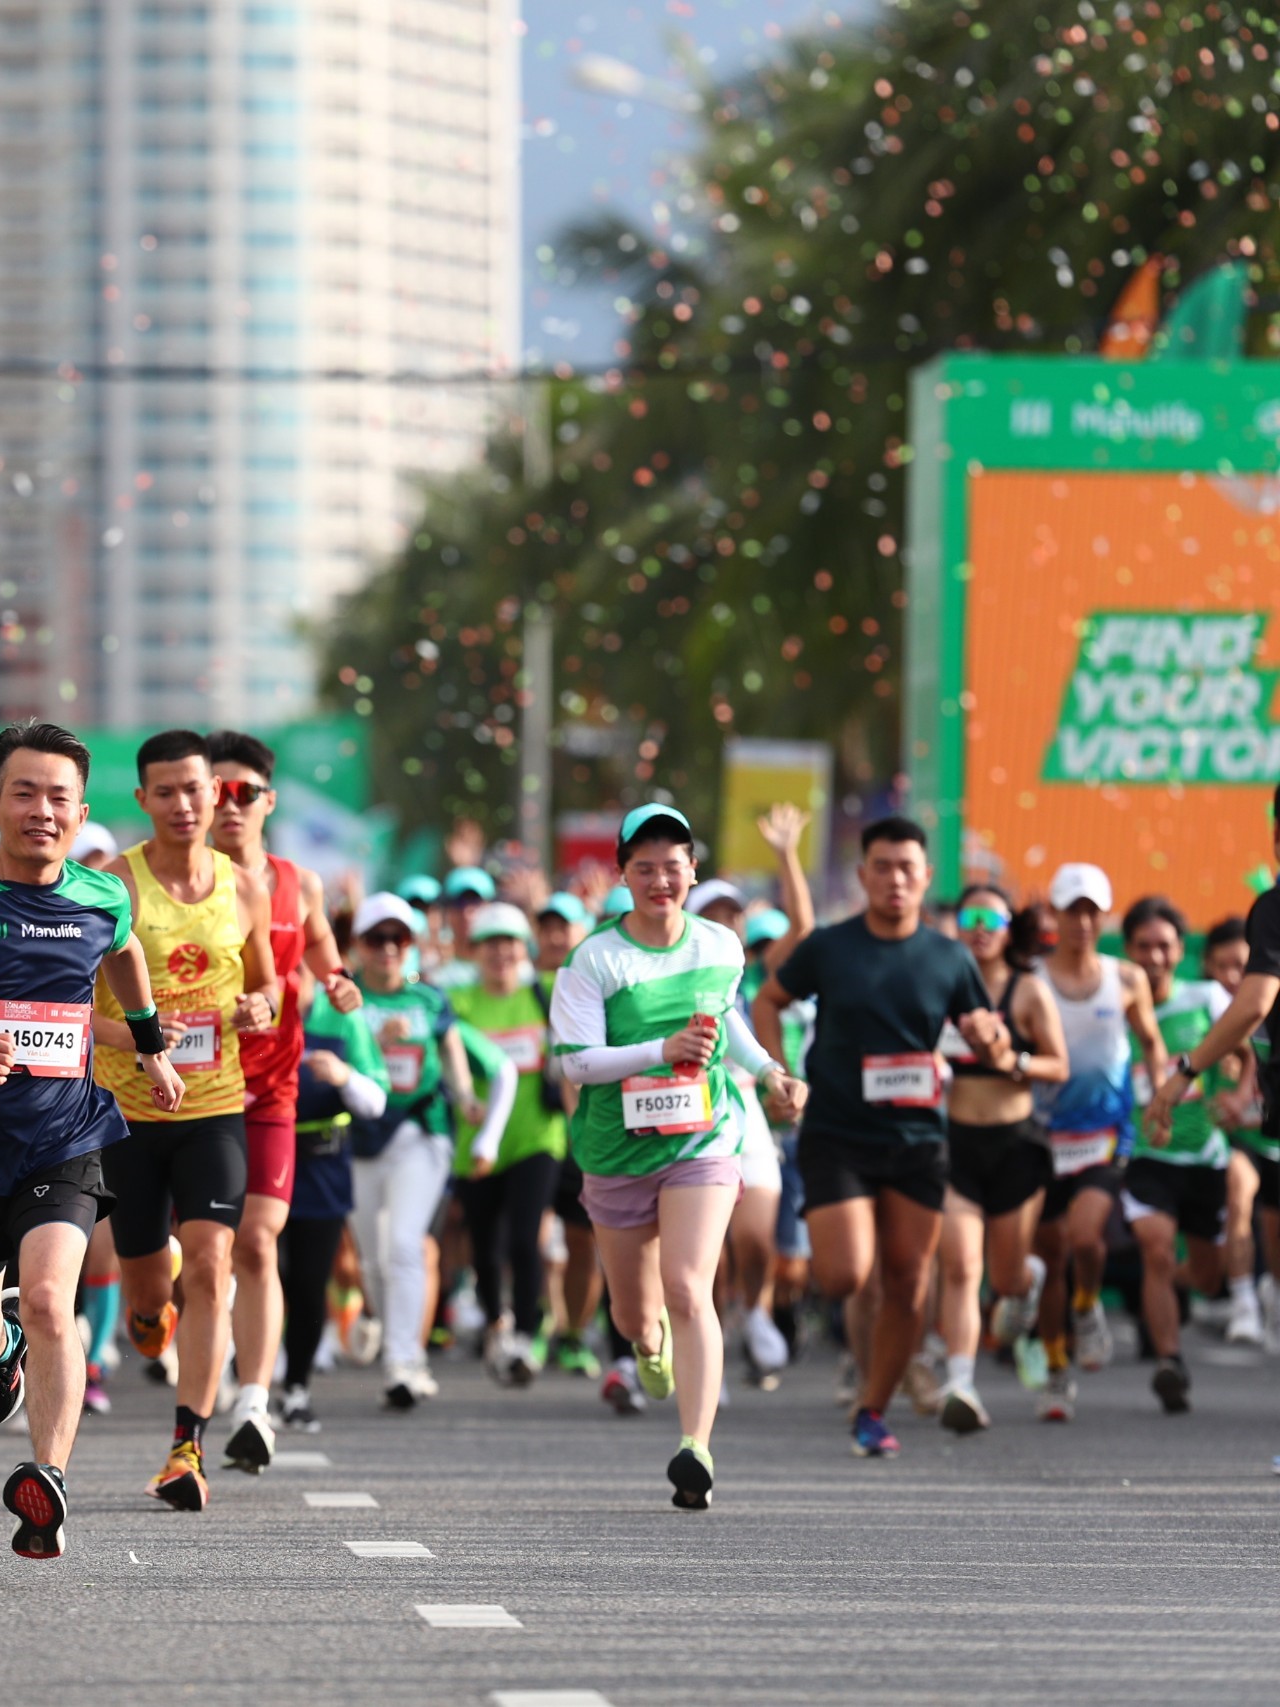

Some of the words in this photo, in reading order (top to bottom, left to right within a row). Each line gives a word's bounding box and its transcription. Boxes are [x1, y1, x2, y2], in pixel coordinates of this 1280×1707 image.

[1091, 614, 1253, 668] FIND
[1072, 671, 1261, 722] YOUR
[1059, 724, 1280, 779] VICTO
[21, 923, 82, 938] Manulife
[636, 1094, 691, 1112] F50372
